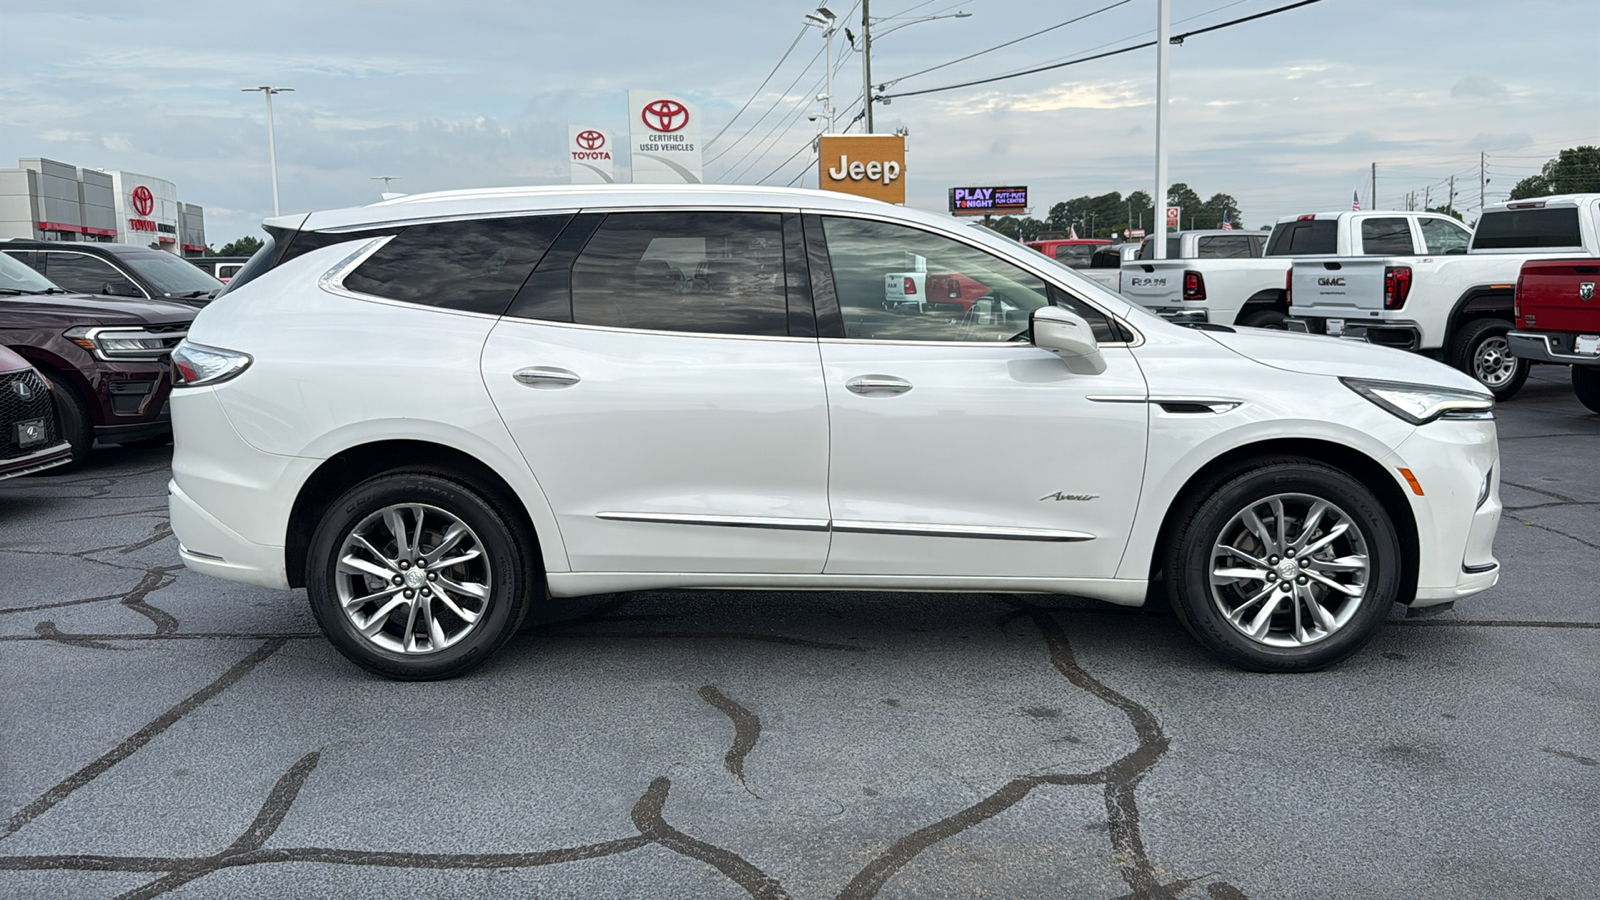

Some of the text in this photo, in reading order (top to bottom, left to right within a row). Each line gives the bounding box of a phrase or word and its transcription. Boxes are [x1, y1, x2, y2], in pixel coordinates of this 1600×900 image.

[649, 134, 684, 142] CERTIFIED
[571, 152, 611, 160] TOYOTA
[829, 155, 900, 184] Jeep
[955, 188, 993, 200] PLAY
[955, 200, 993, 208] TONIGHT
[129, 219, 157, 232] TOYOTA
[1131, 277, 1167, 287] RAM
[1317, 277, 1347, 287] GMC
